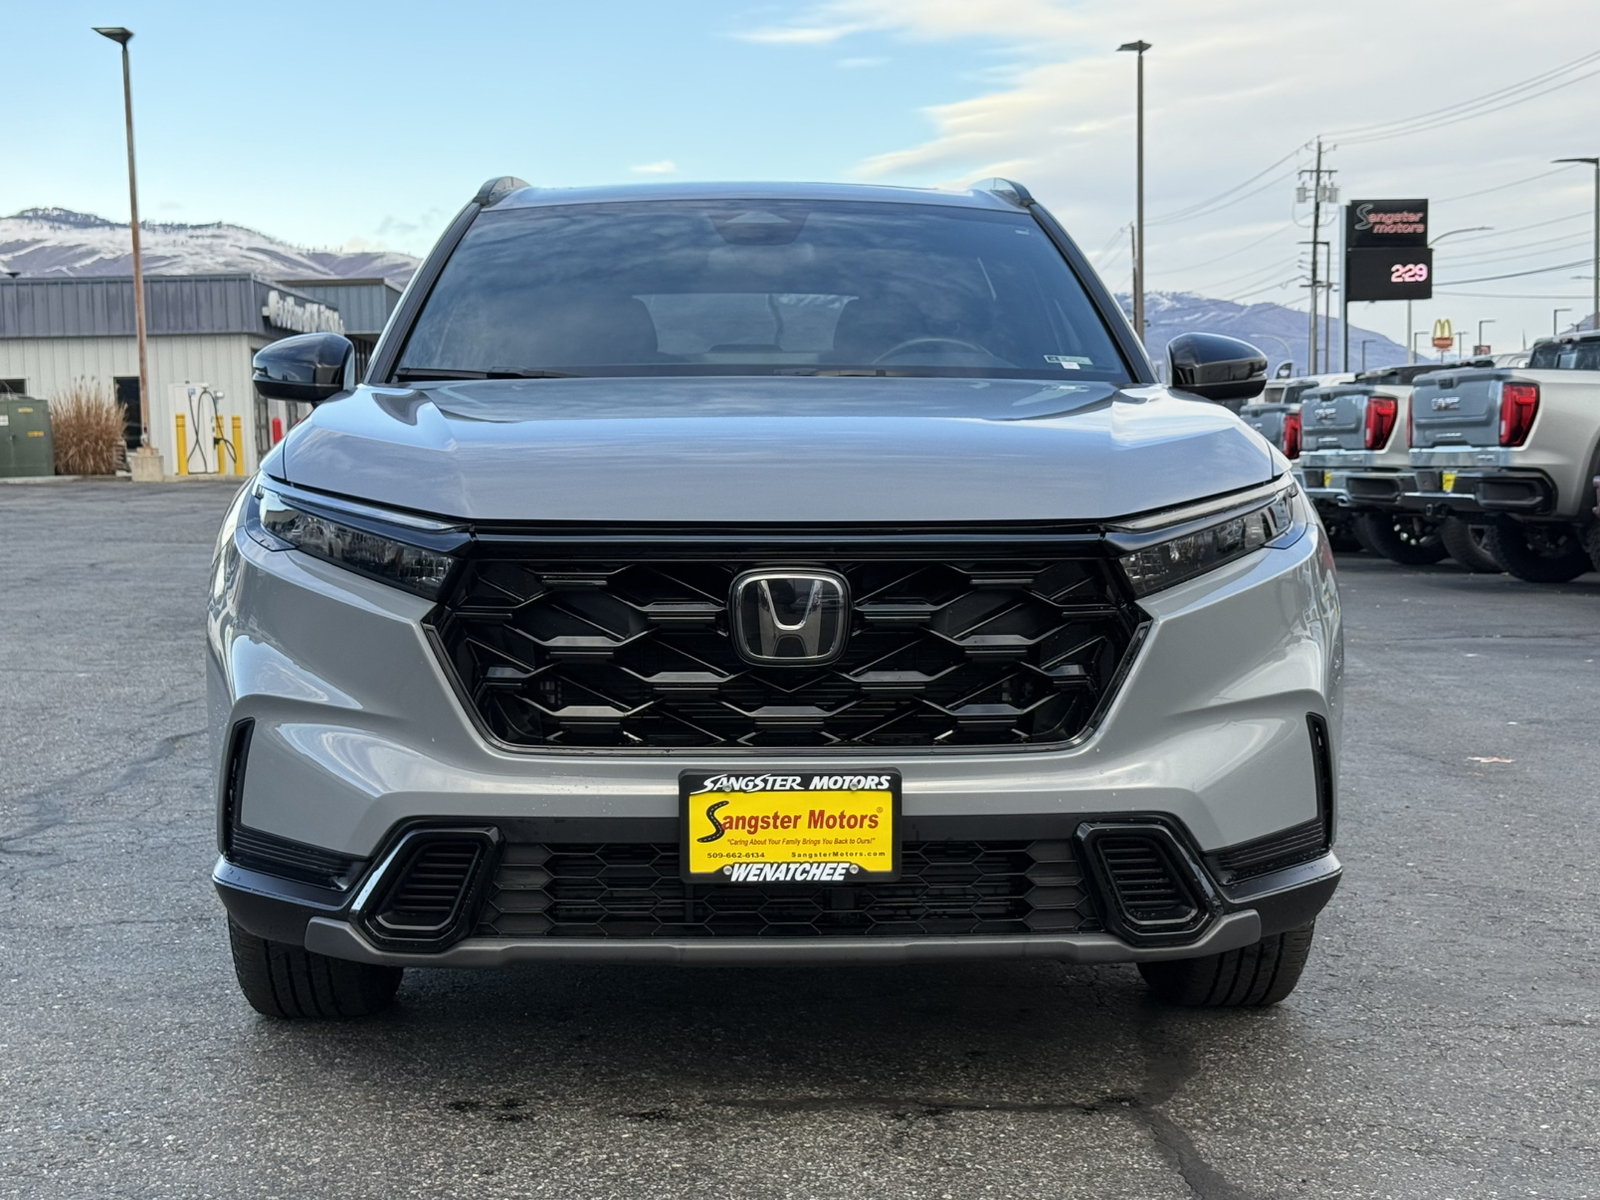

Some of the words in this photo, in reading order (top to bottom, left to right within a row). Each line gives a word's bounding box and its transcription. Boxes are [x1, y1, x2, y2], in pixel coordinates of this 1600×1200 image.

[1354, 203, 1424, 230] Sangster
[690, 773, 805, 794] SANGSTER
[809, 775, 891, 790] MOTORS
[697, 800, 802, 843] Sangster
[782, 838, 800, 846] Family
[802, 838, 820, 846] Brings
[791, 850, 886, 859] SangsterMotors.com
[730, 862, 850, 882] WENATCHEE
